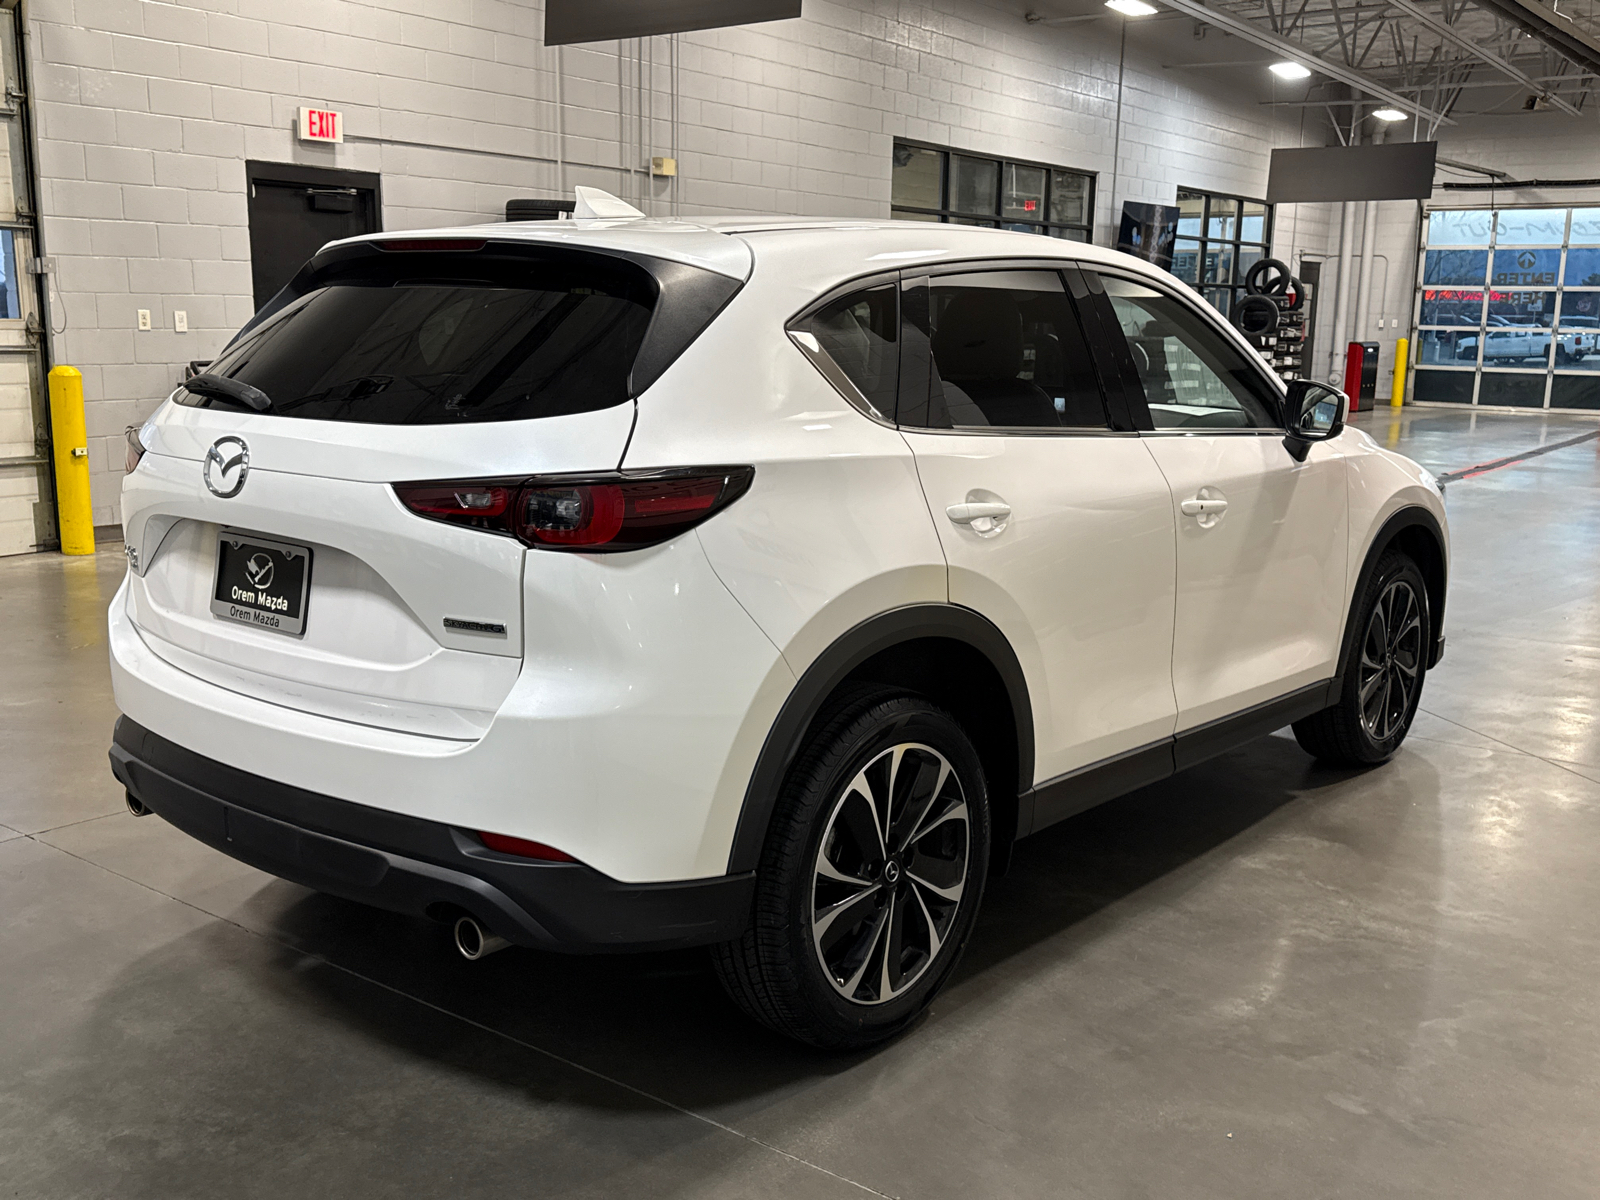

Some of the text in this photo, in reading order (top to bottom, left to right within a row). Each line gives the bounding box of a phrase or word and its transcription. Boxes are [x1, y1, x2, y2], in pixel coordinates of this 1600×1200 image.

[309, 110, 337, 139] EXIT
[231, 585, 288, 610] Orem Mazda
[230, 605, 280, 627] Orem Mazda
